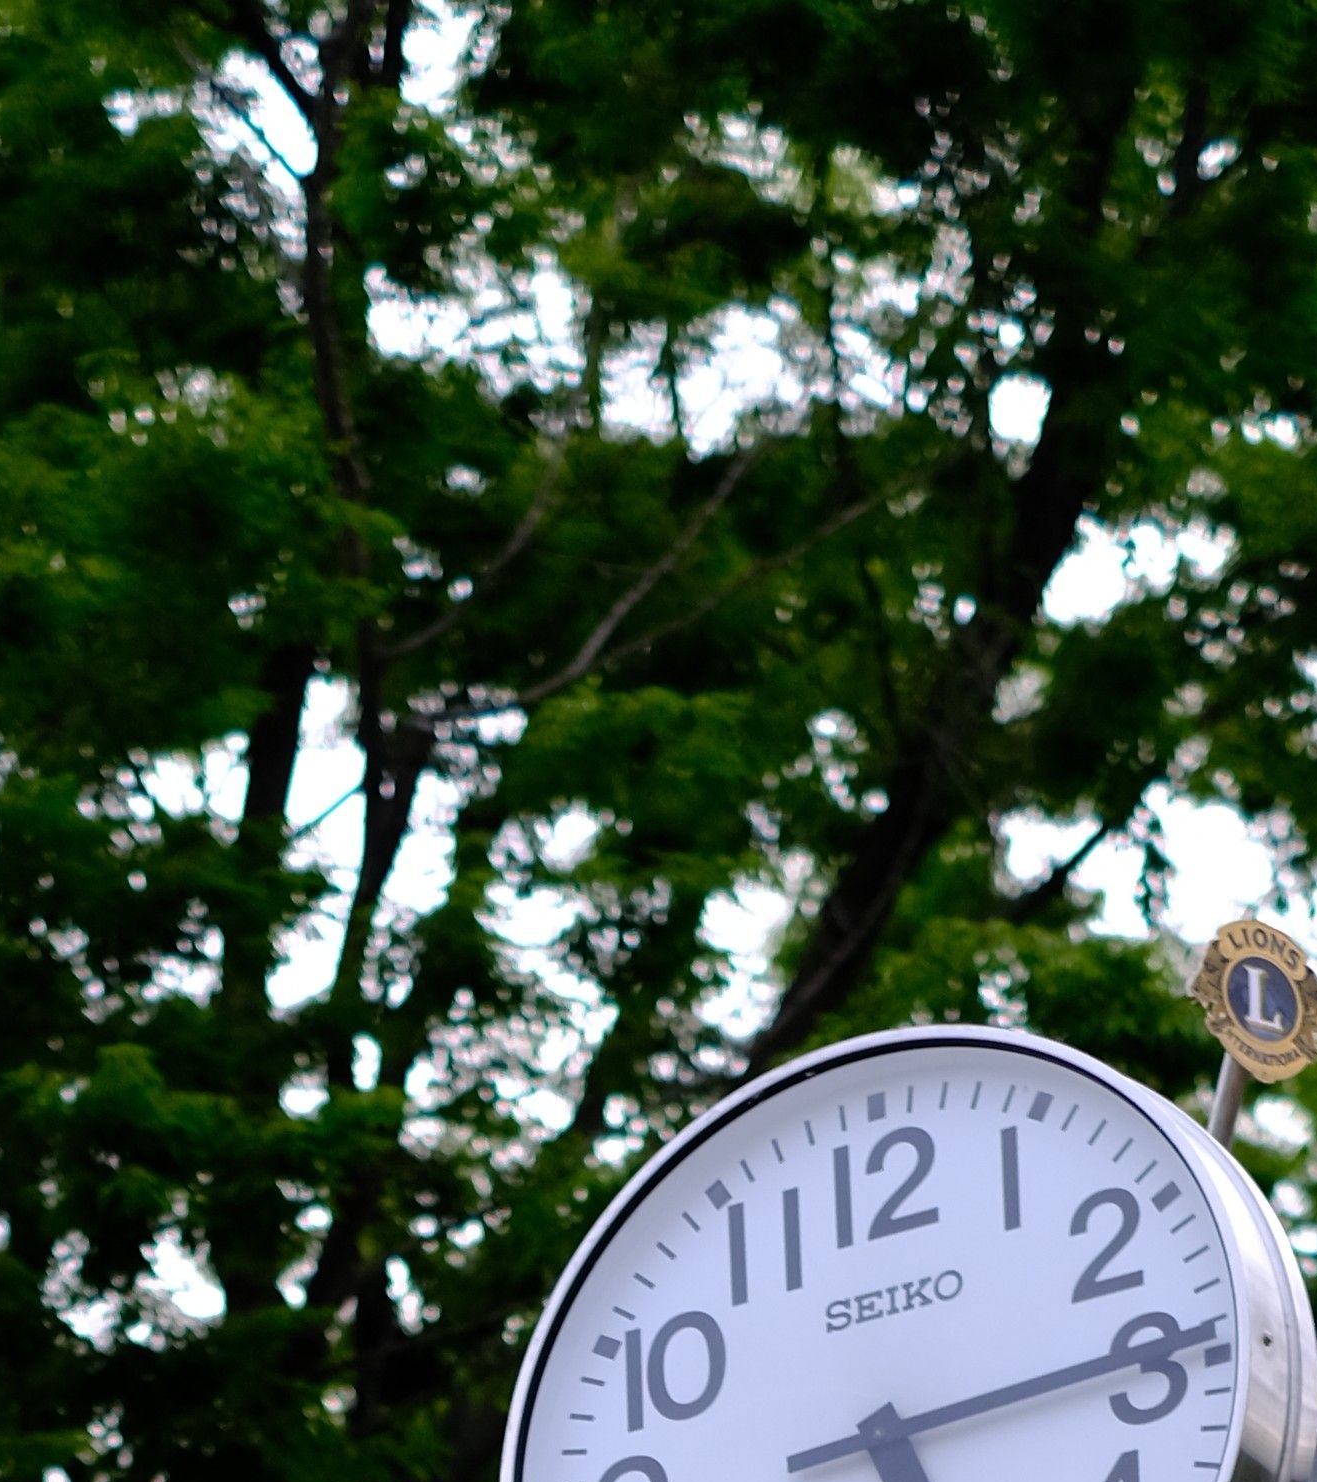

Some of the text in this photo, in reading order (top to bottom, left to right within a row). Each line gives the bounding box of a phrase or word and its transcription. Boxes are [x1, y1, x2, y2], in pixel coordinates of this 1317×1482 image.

[1227, 928, 1300, 970] LIONS
[1243, 964, 1283, 1032] L
[834, 1125, 939, 1247] 12
[1001, 1126, 1021, 1231] 1
[727, 1187, 802, 1306] 11
[826, 1270, 963, 1333] SEIKO
[1070, 1188, 1144, 1304] 2
[624, 1310, 726, 1432] 10
[1108, 1312, 1189, 1425] 3
